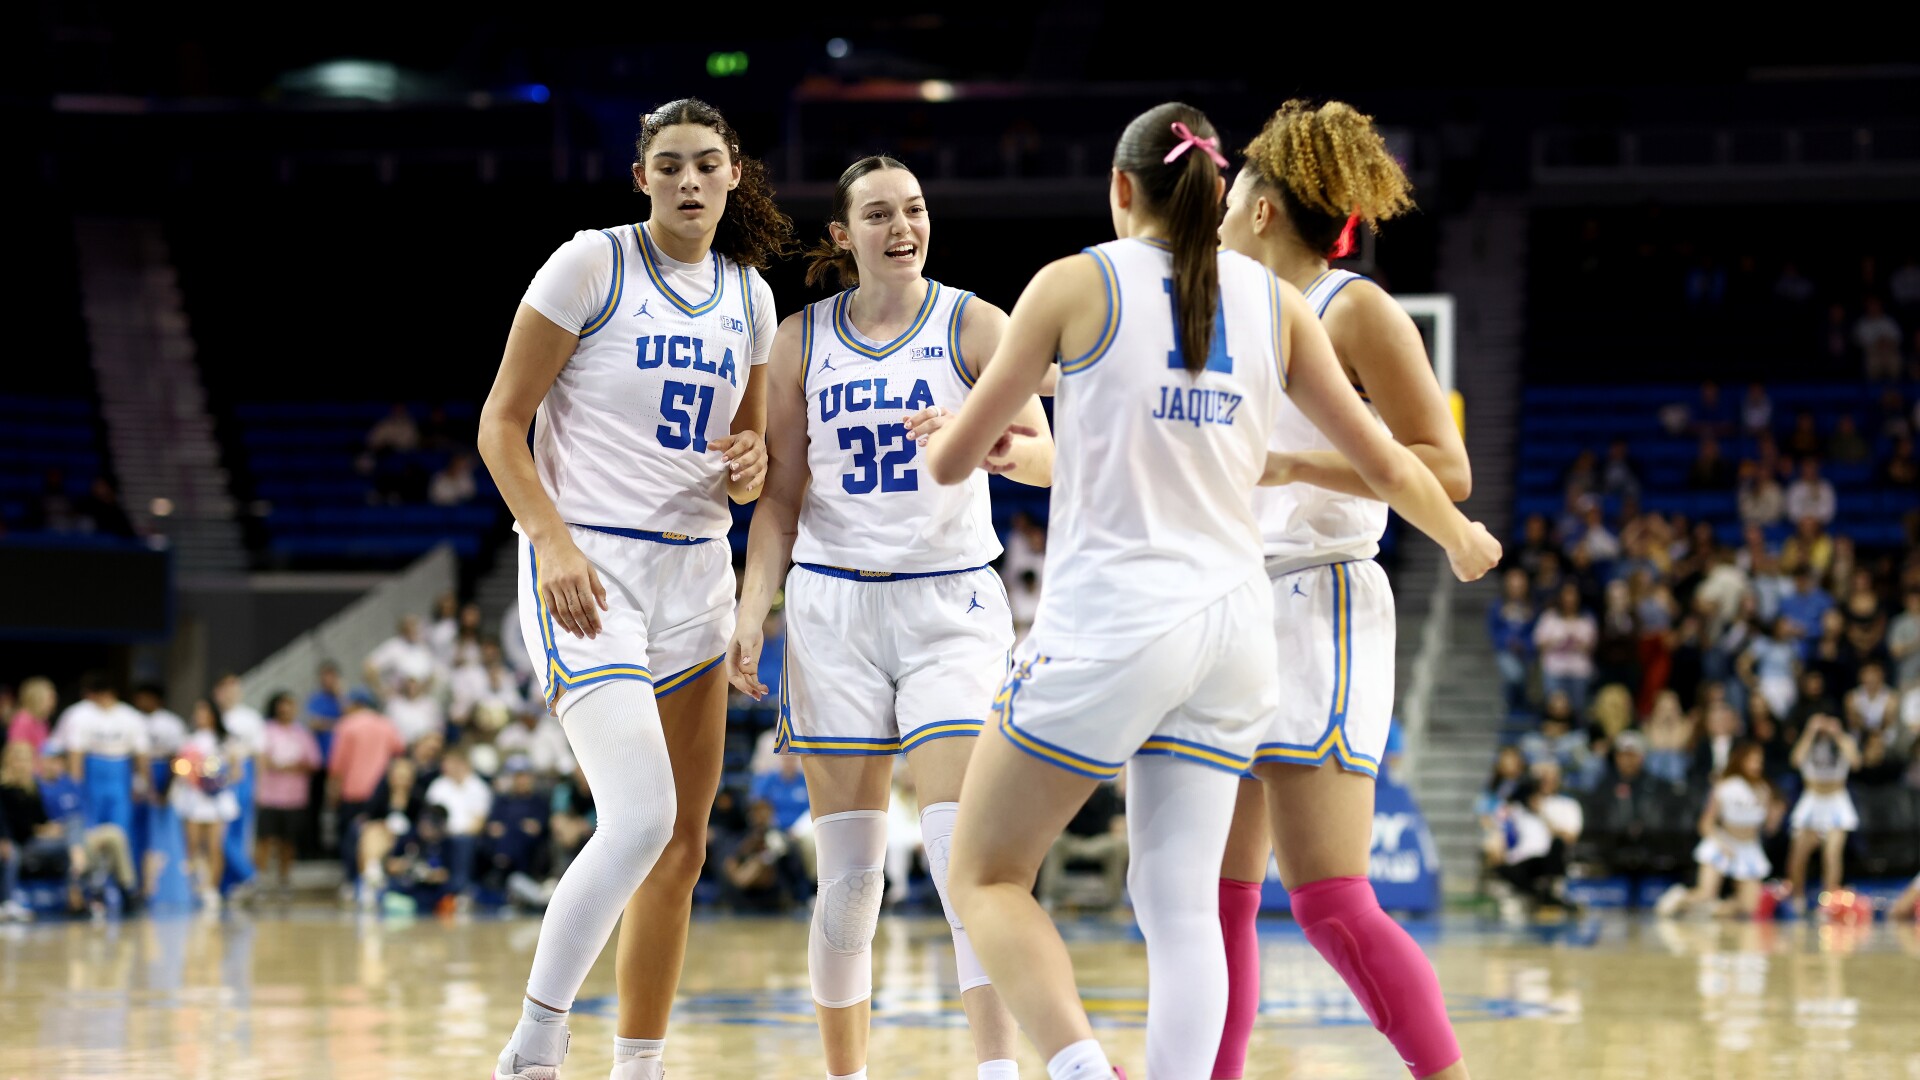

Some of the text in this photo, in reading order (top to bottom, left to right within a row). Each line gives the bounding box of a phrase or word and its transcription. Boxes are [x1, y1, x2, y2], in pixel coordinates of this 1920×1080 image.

[636, 335, 736, 388] UCLA
[656, 380, 715, 454] 51
[819, 378, 935, 423] UCLA
[1152, 386, 1243, 428] JAQUEZ
[837, 423, 919, 495] 32
